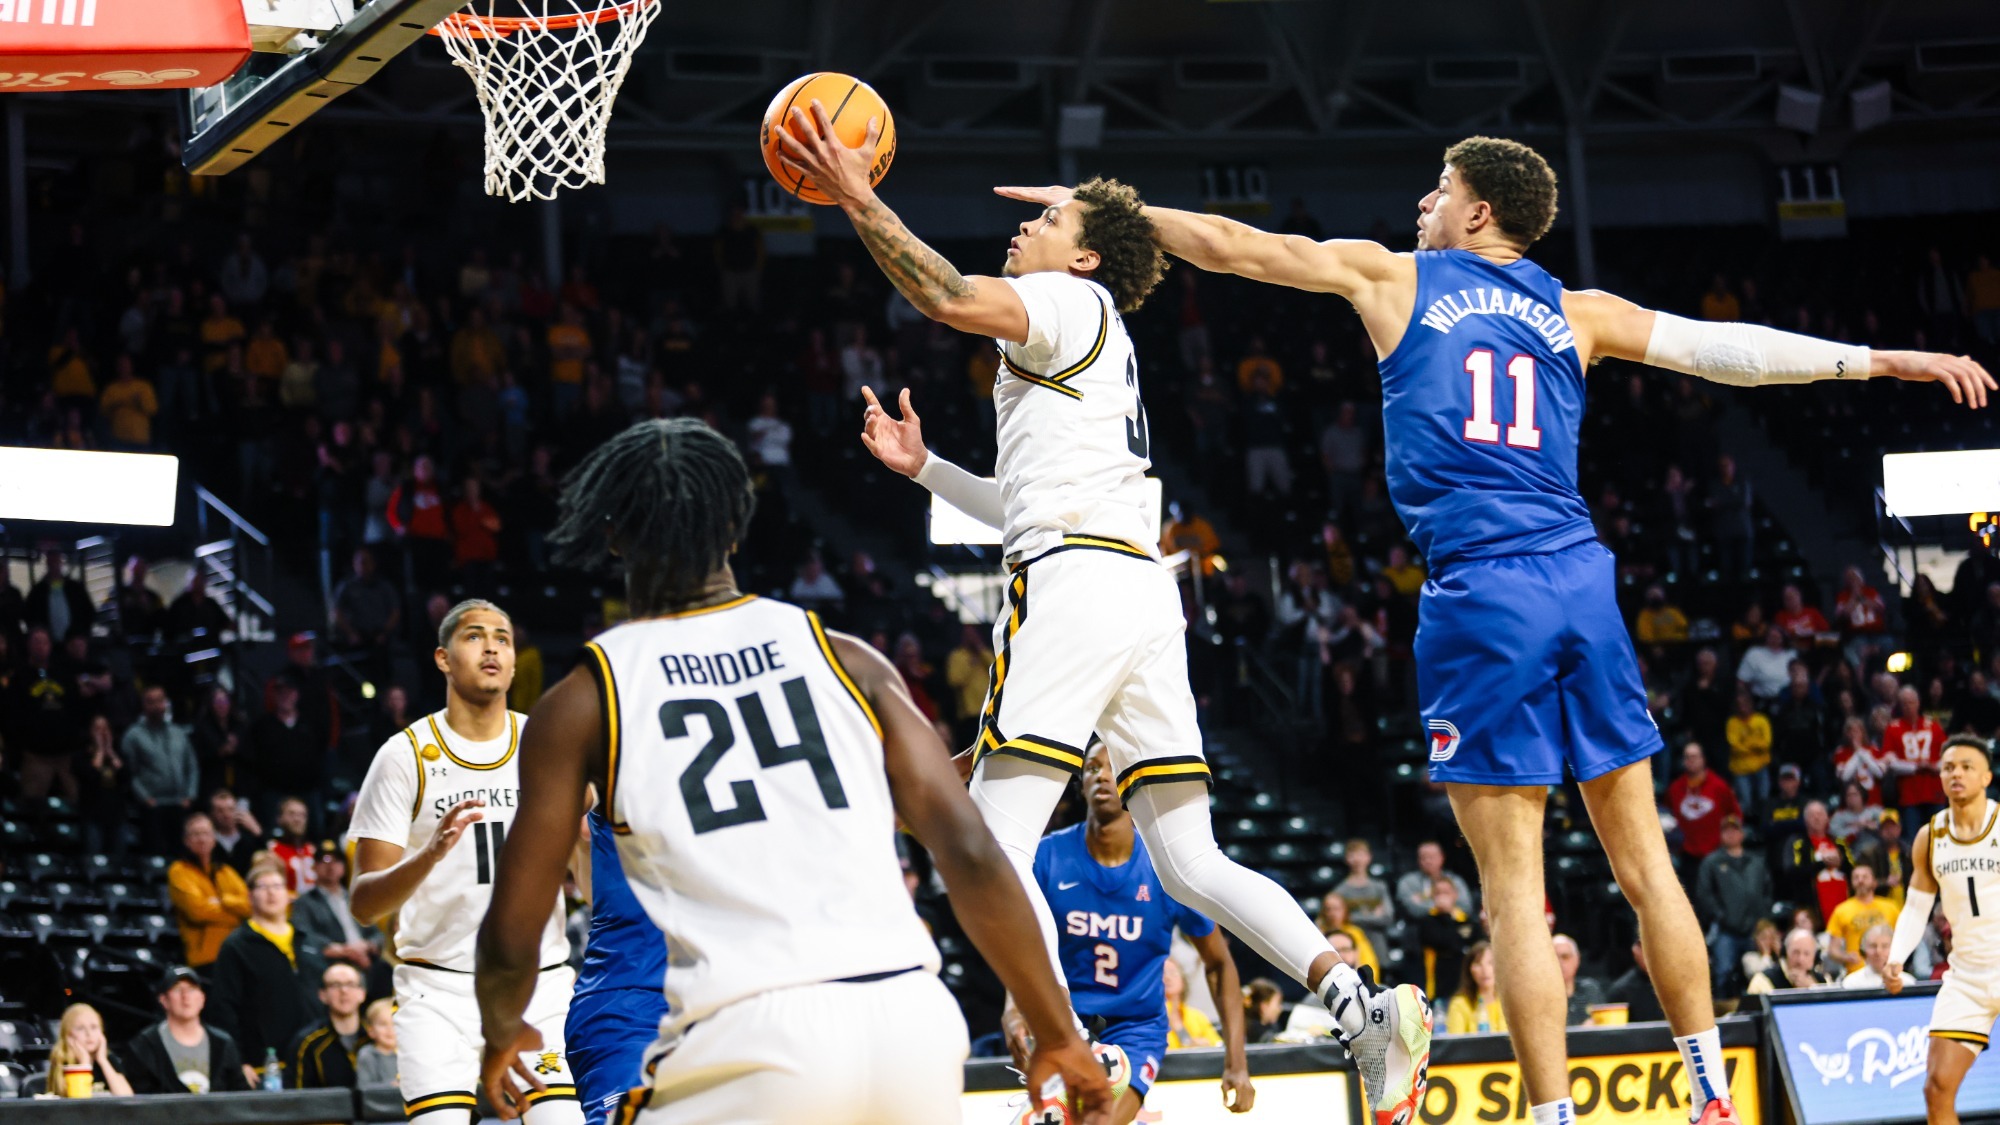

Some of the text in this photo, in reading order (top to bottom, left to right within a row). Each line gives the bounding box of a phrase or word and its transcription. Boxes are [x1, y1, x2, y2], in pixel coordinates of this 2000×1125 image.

[743, 179, 808, 216] 10
[1204, 167, 1267, 202] 110
[1779, 167, 1841, 202] 111
[1420, 287, 1575, 354] WILLIAMSON
[1464, 348, 1542, 450] 11
[658, 675, 850, 835] 24
[1902, 731, 1932, 760] 87
[1967, 876, 1980, 917] 1
[1066, 910, 1144, 941] SMU
[1094, 943, 1118, 988] 2
[1847, 1026, 1930, 1084] Dill
